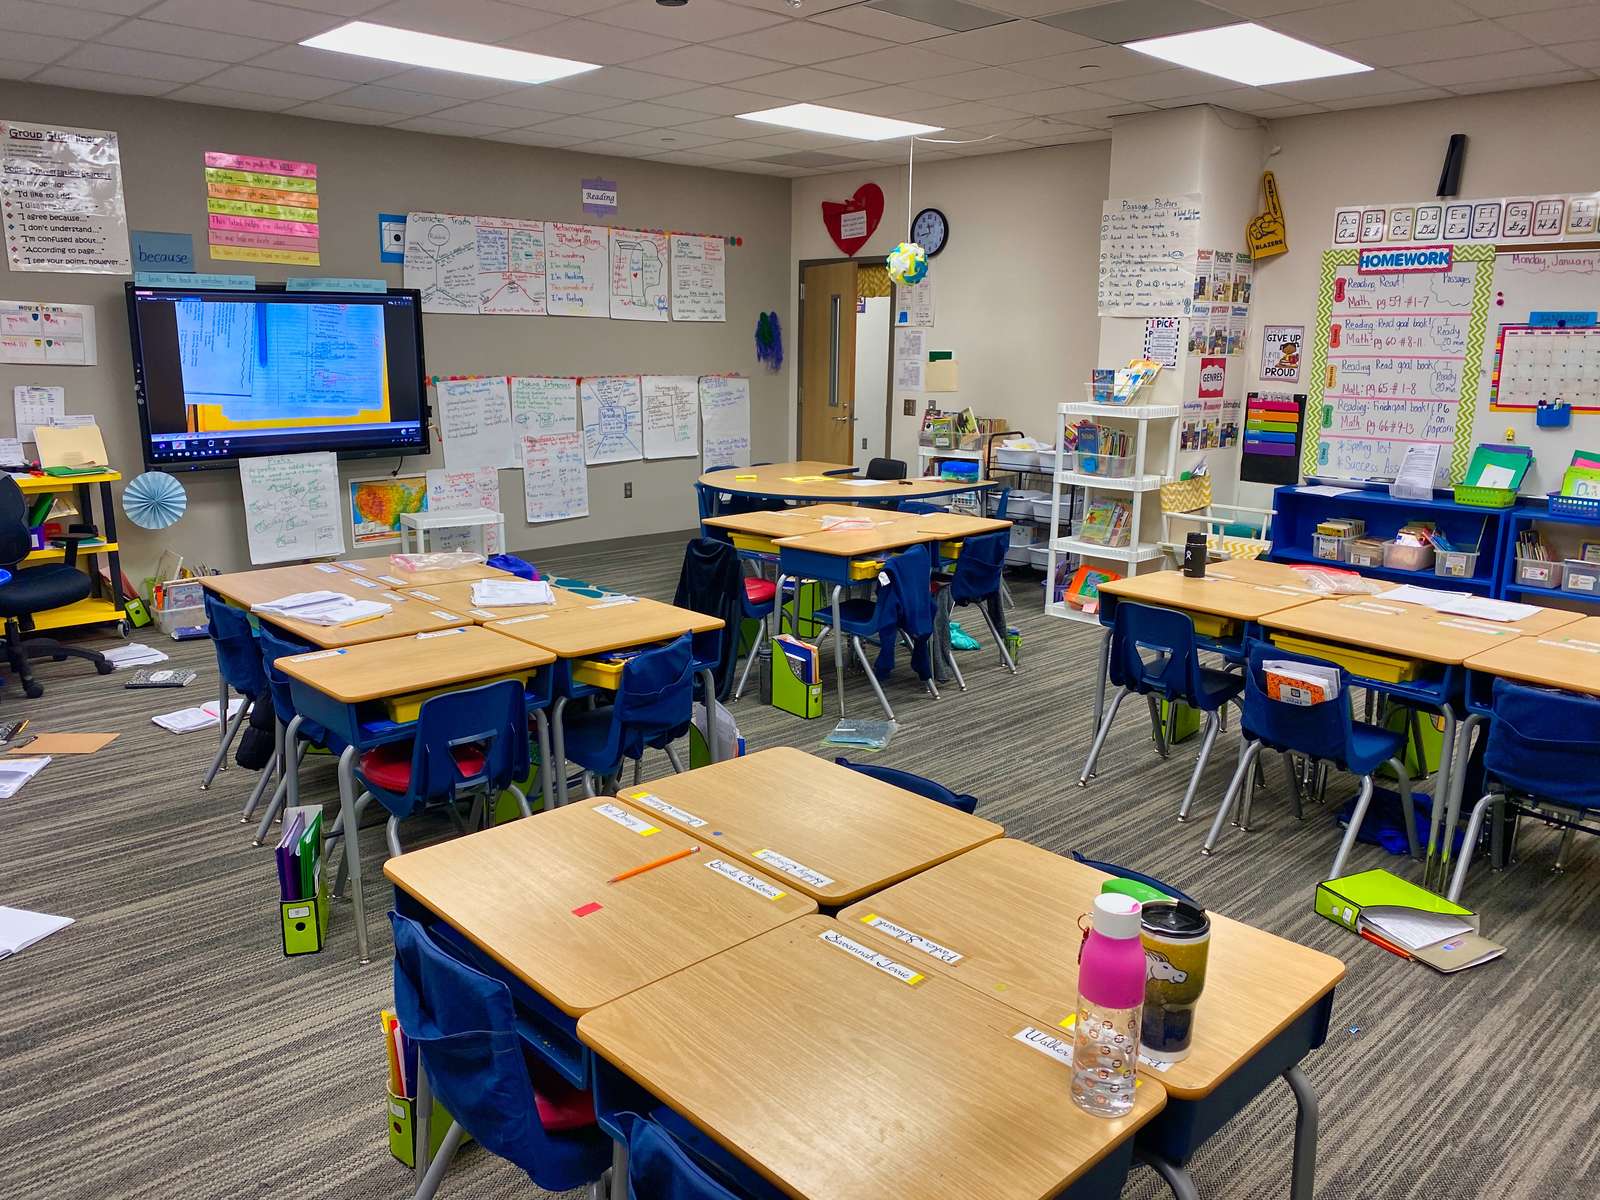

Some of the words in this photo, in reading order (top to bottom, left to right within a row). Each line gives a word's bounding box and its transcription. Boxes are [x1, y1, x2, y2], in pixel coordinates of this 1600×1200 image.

[9, 128, 43, 140] Group
[586, 192, 615, 204] Reading
[1122, 200, 1148, 212] Passage
[27, 215, 47, 223] agree
[37, 236, 73, 244] confused
[1255, 240, 1283, 250] BLAZERS
[138, 244, 189, 265] because
[1360, 252, 1450, 269] HOMEWORK
[46, 258, 63, 266] your
[1552, 255, 1593, 273] January
[1348, 277, 1376, 290] Reading
[1443, 273, 1471, 285] Passages
[1347, 297, 1371, 308] Math
[1389, 295, 1402, 306] 59
[18, 304, 39, 312] HOUE
[40, 304, 64, 313] PONTS
[1378, 319, 1396, 328] Read
[1267, 334, 1287, 342] GIVE
[1290, 334, 1301, 342] UP
[1437, 326, 1461, 338] Ready
[1386, 337, 1397, 346] 60
[1265, 367, 1296, 377] PROUD
[1375, 360, 1393, 370] Read
[1398, 361, 1413, 375] goal
[1202, 371, 1223, 383] GENRES
[1378, 382, 1388, 394] 65
[1341, 415, 1360, 430] Math
[1366, 419, 1376, 433] pg
[1378, 419, 1390, 431] 66
[1426, 424, 1454, 438] popcorn
[924, 941, 957, 962] Parker
[1025, 1028, 1070, 1057] Walker
